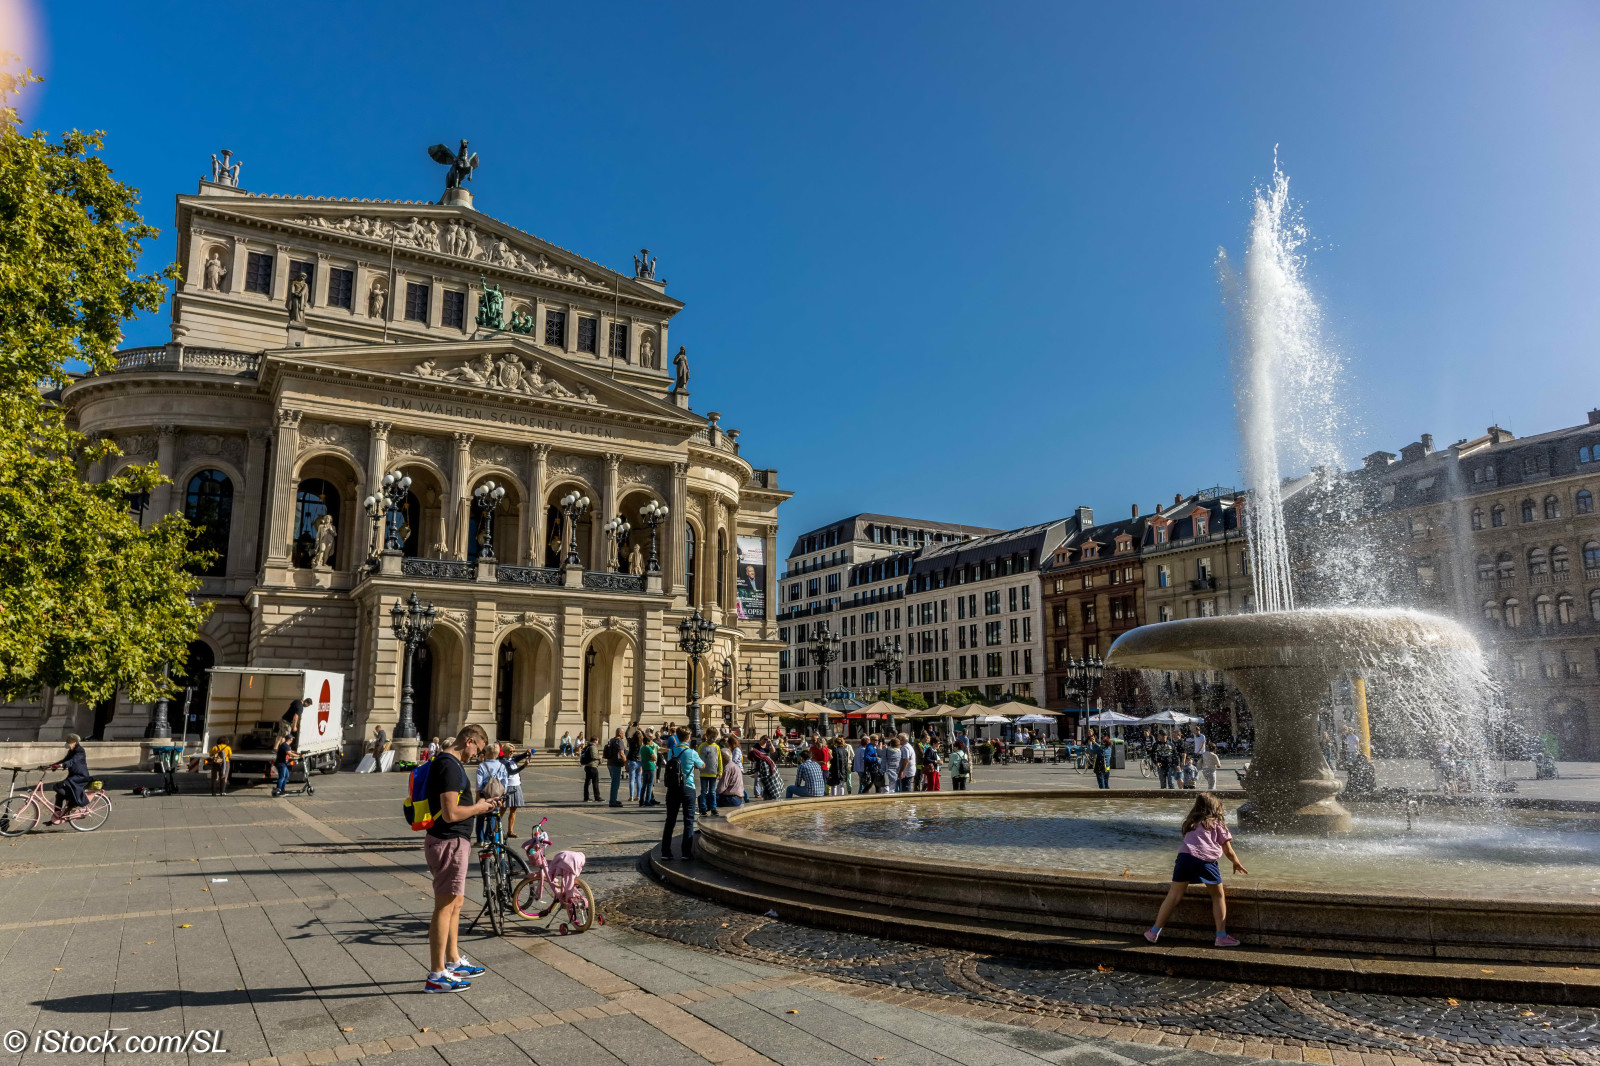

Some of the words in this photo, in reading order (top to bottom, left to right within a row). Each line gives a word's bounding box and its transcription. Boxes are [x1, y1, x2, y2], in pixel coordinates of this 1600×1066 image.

[380, 395, 412, 410] DEM
[420, 402, 482, 419] WAHREN
[490, 412, 563, 431] SCHOENEN
